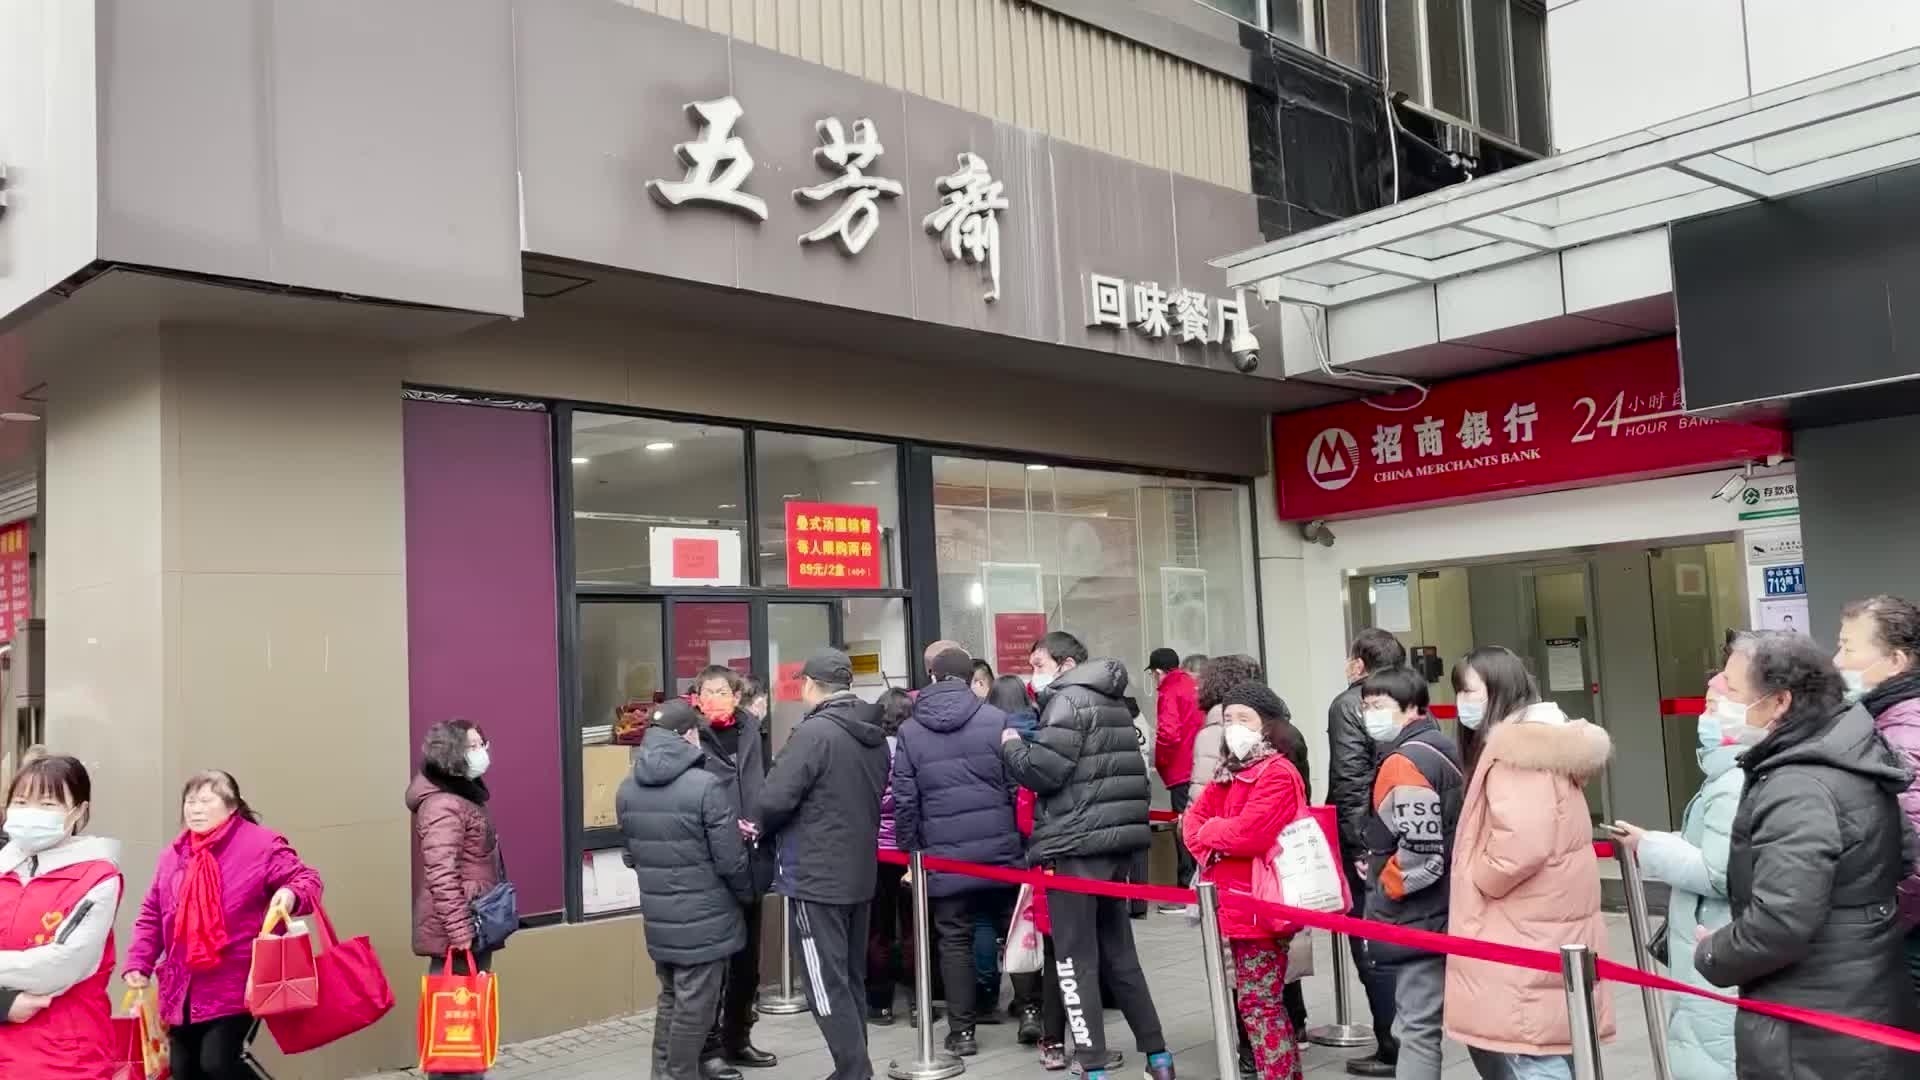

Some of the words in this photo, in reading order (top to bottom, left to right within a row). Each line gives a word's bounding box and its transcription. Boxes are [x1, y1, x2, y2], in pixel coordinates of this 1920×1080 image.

[1371, 402, 1539, 465] 招商银行
[1571, 390, 1625, 443] 24
[1626, 421, 1667, 437] HOUR
[1374, 470, 1414, 483] CHINA
[1416, 455, 1498, 477] MERCHANTS
[1501, 448, 1541, 465] BANK
[1060, 978, 1081, 1006] DO
[1067, 1007, 1092, 1048] JUST
